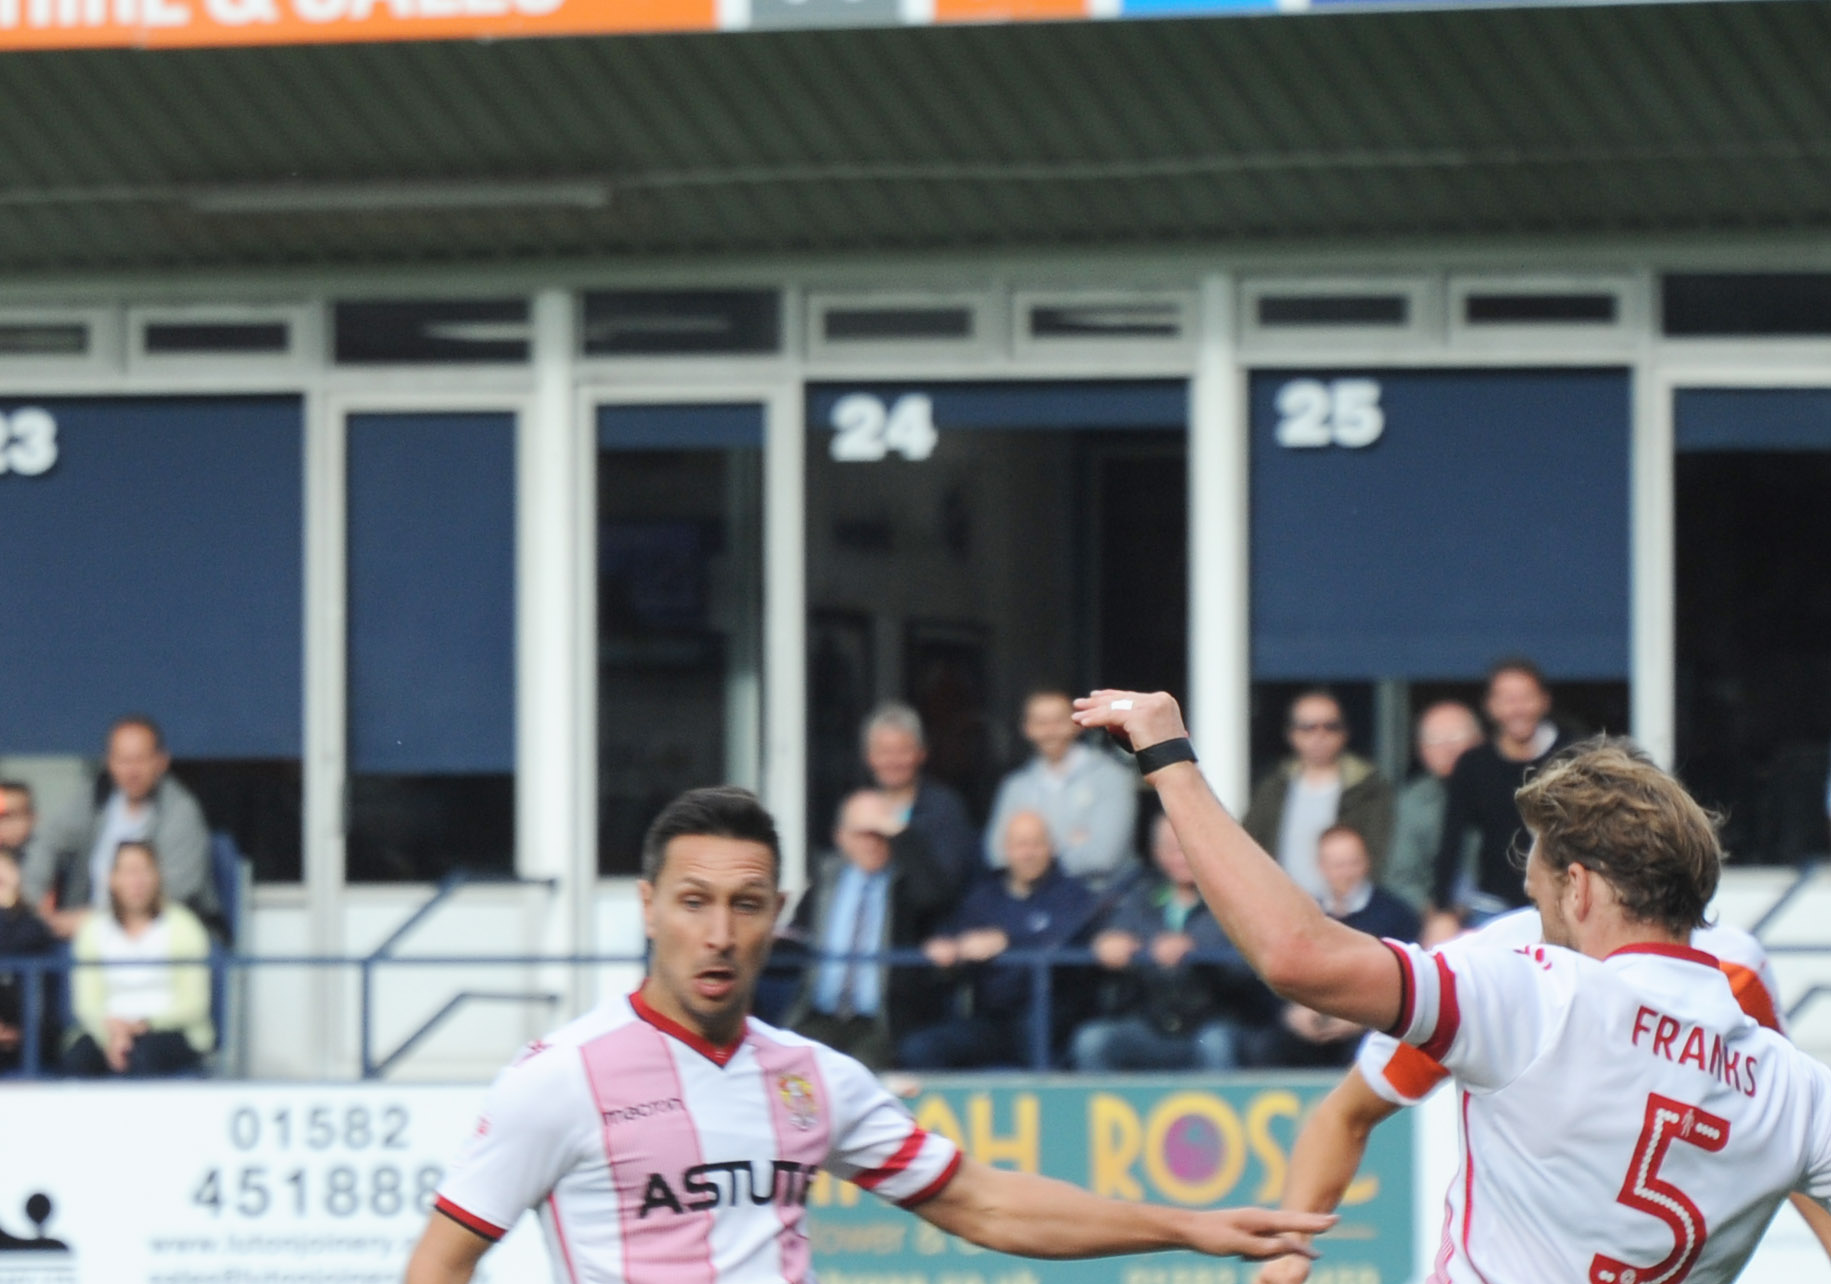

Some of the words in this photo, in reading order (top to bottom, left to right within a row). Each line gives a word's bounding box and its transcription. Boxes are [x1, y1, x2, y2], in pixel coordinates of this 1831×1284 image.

[830, 391, 938, 461] 24
[1276, 378, 1384, 450] 25
[229, 1106, 412, 1150] 01582
[1088, 1090, 1380, 1211] ROS
[191, 1164, 447, 1218] 451888
